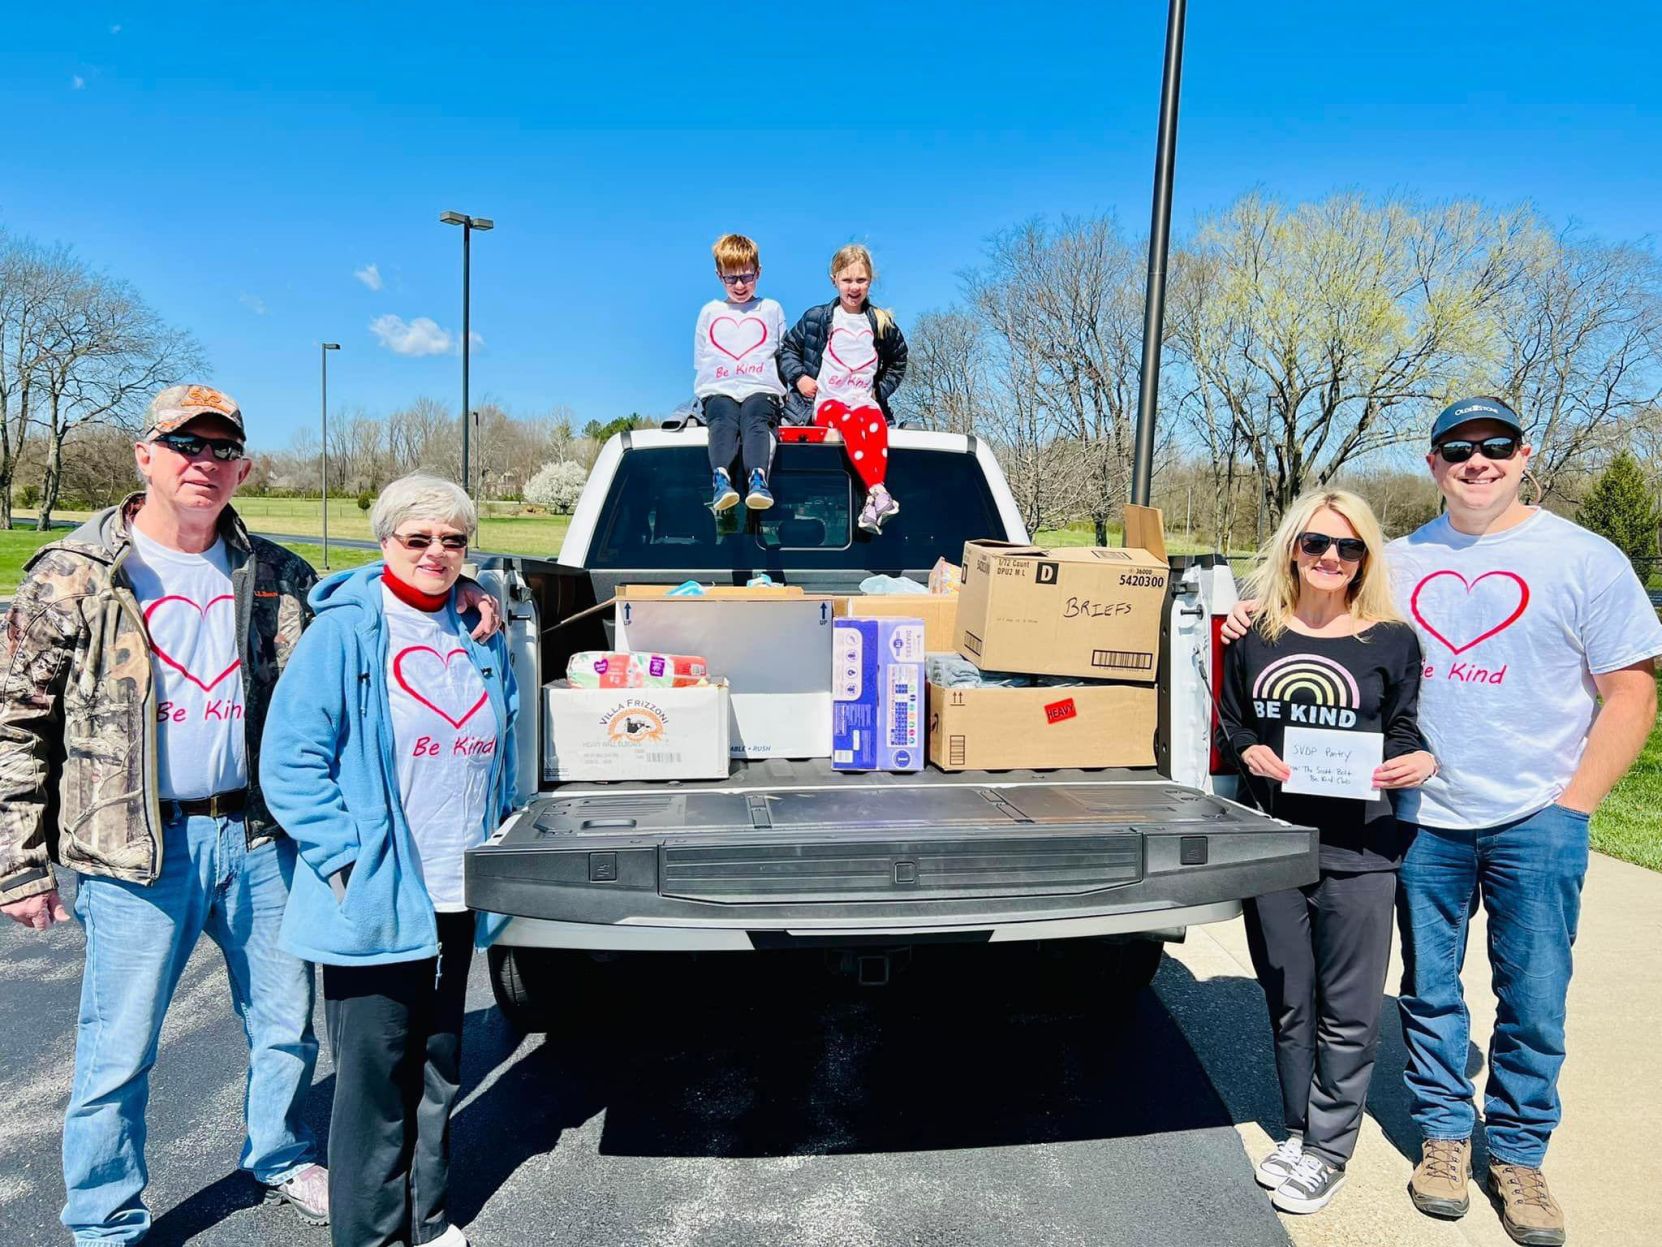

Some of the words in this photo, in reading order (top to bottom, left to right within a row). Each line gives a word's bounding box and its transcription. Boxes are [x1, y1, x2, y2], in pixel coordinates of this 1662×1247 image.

[715, 366, 729, 379] Be
[736, 362, 765, 376] Kind
[828, 375, 843, 387] Be
[1012, 560, 1030, 569] Count
[1040, 564, 1054, 582] D
[1119, 574, 1164, 588] 5420300
[1063, 596, 1132, 618] BRIEFS
[1447, 661, 1508, 685] Kind
[156, 701, 187, 722] Be
[204, 699, 245, 721] Kin
[599, 703, 626, 727] VILLA
[626, 698, 670, 725] FRIZZONI
[1047, 703, 1074, 721] HEAVY
[1253, 700, 1281, 719] BE
[1290, 703, 1357, 729] KIND
[412, 736, 440, 757] Be
[453, 735, 497, 756] Kind
